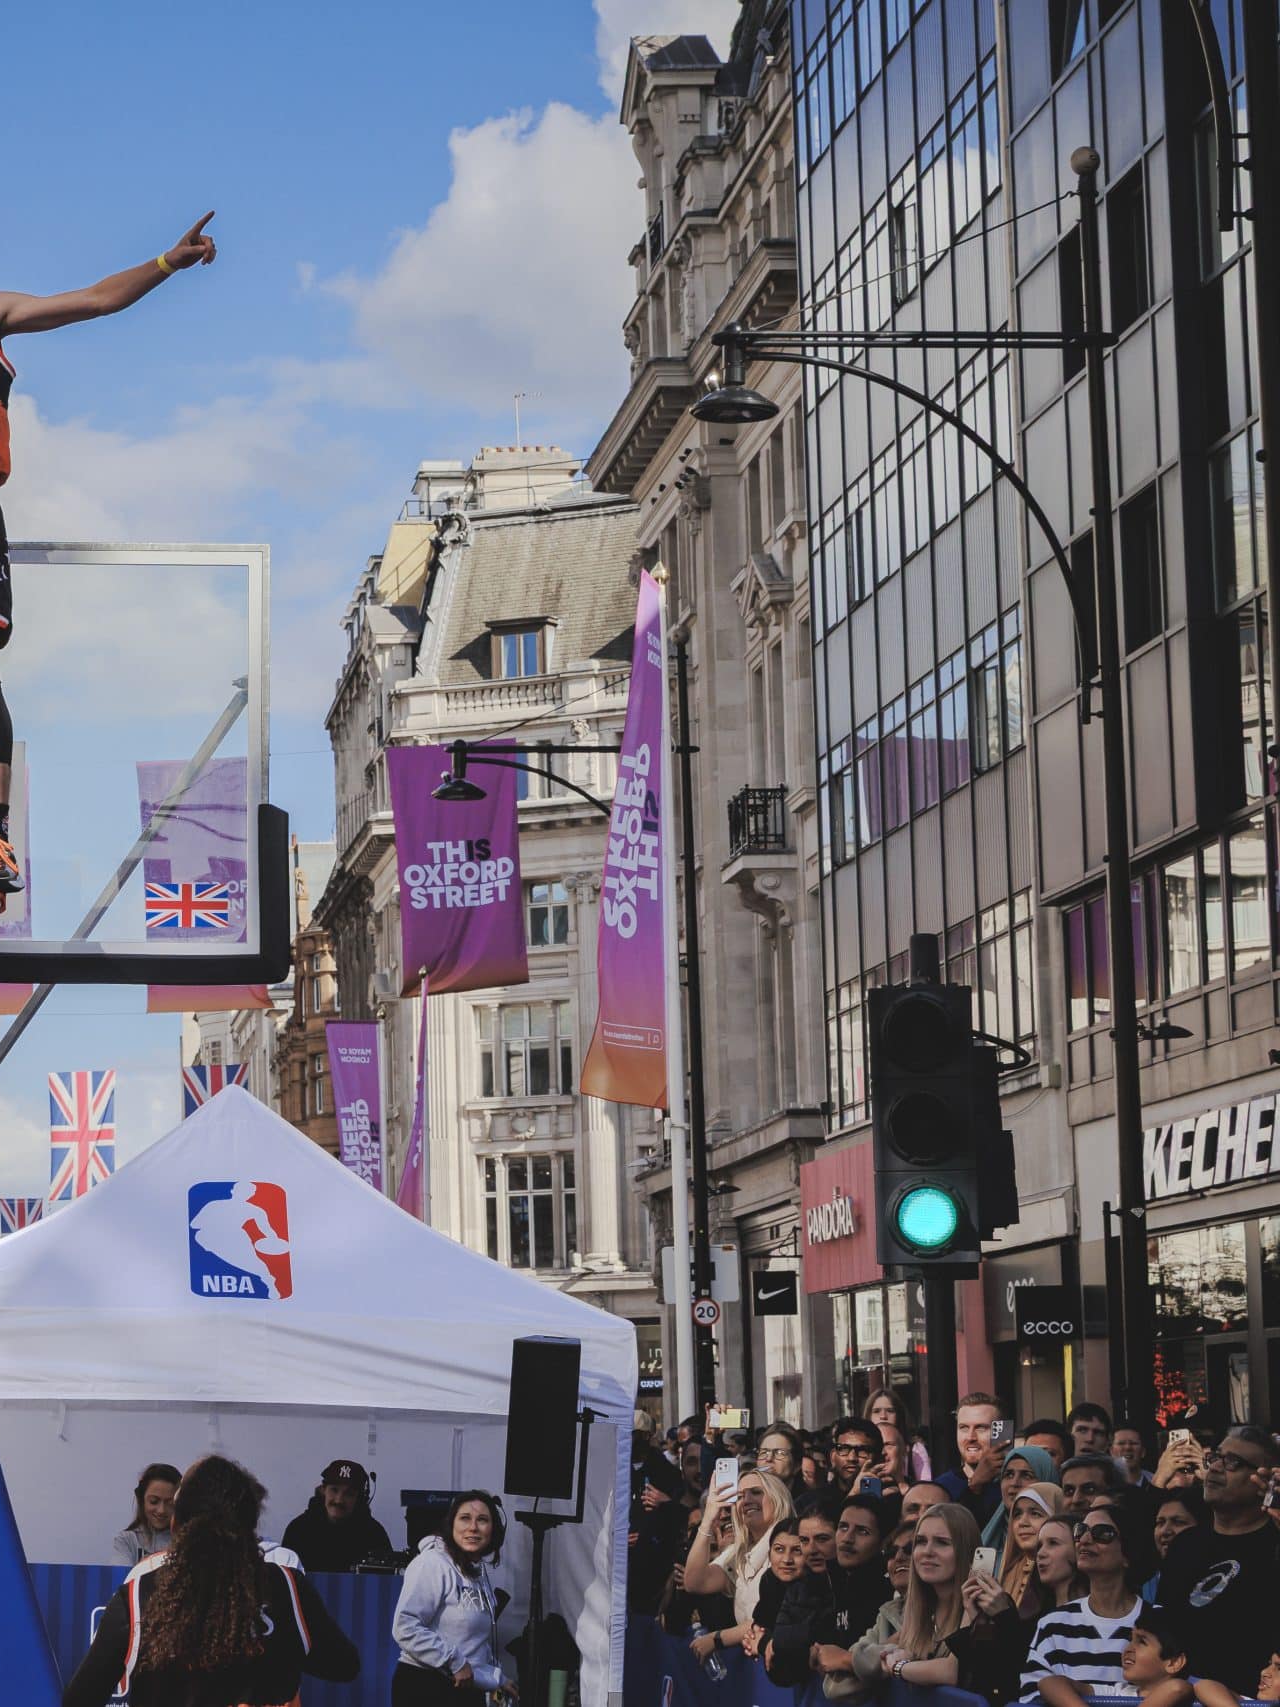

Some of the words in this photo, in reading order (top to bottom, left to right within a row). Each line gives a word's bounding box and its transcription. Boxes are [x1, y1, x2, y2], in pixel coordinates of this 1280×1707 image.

[427, 839, 491, 864] THIS
[404, 857, 515, 887] OXFORD
[410, 879, 511, 909] STREET
[1143, 1094, 1280, 1200] KECHE
[807, 1194, 854, 1246] PANDORA
[202, 1275, 255, 1293] NBA
[697, 1306, 716, 1318] 20
[1024, 1321, 1073, 1335] ecco
